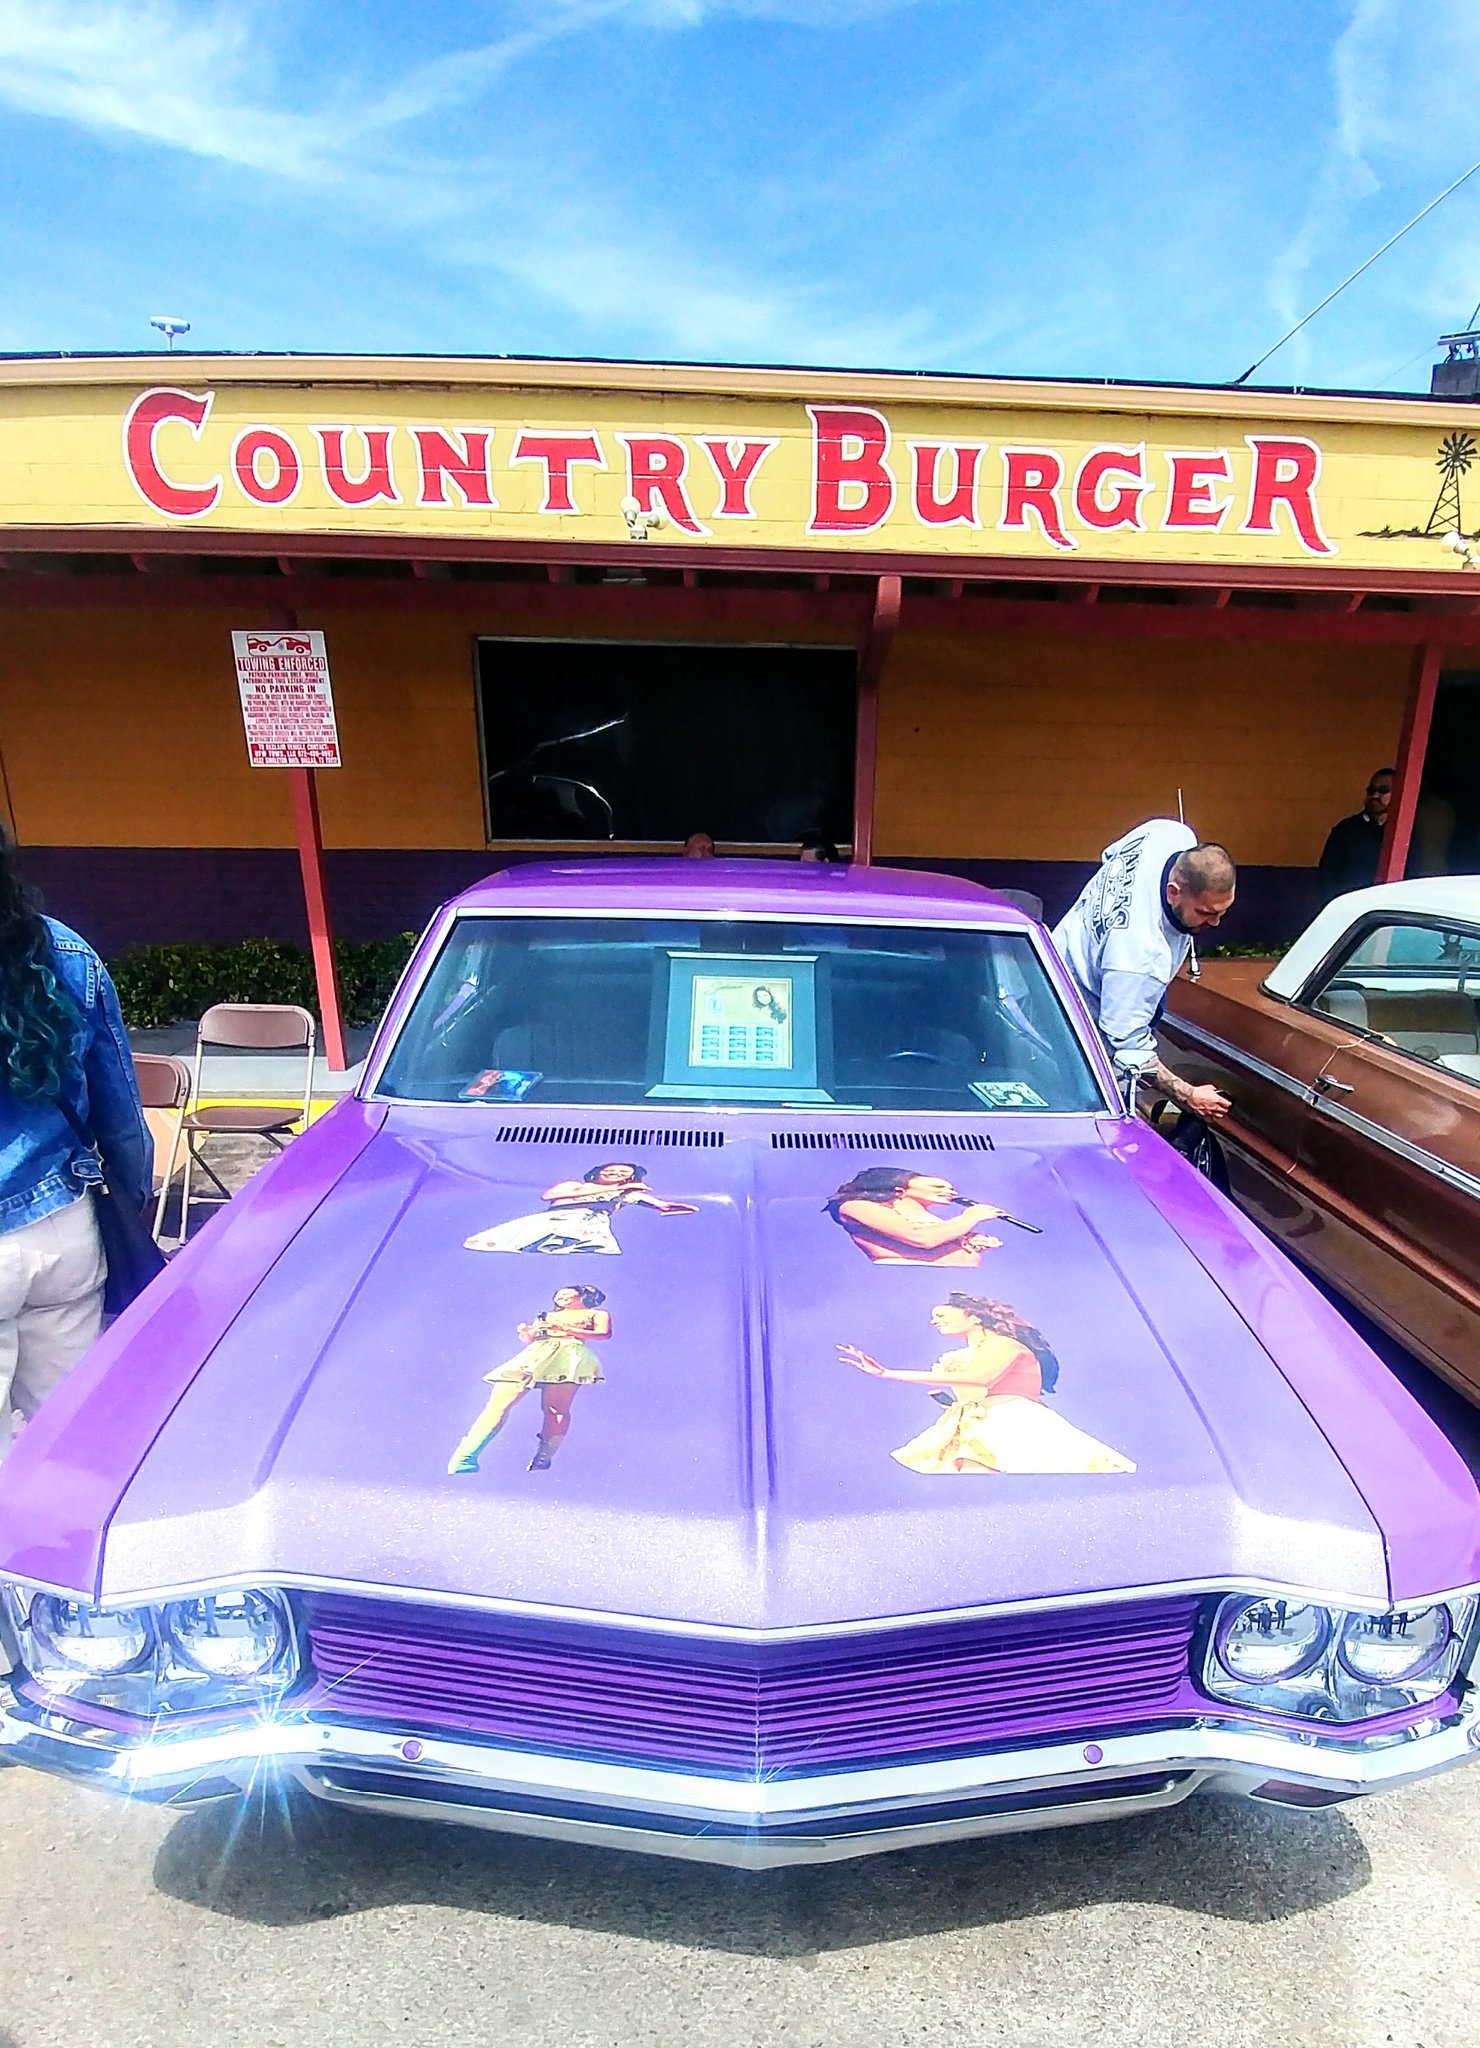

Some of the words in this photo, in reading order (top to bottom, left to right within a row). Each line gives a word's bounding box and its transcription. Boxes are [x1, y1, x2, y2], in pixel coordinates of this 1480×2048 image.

[122, 387, 781, 538] COUNTRY
[806, 405, 1339, 557] BURGER
[238, 657, 275, 671] TOWING
[278, 657, 325, 671] ENFORCED
[255, 685, 267, 694] NO
[270, 685, 304, 694] PARKING
[307, 685, 316, 693] IN
